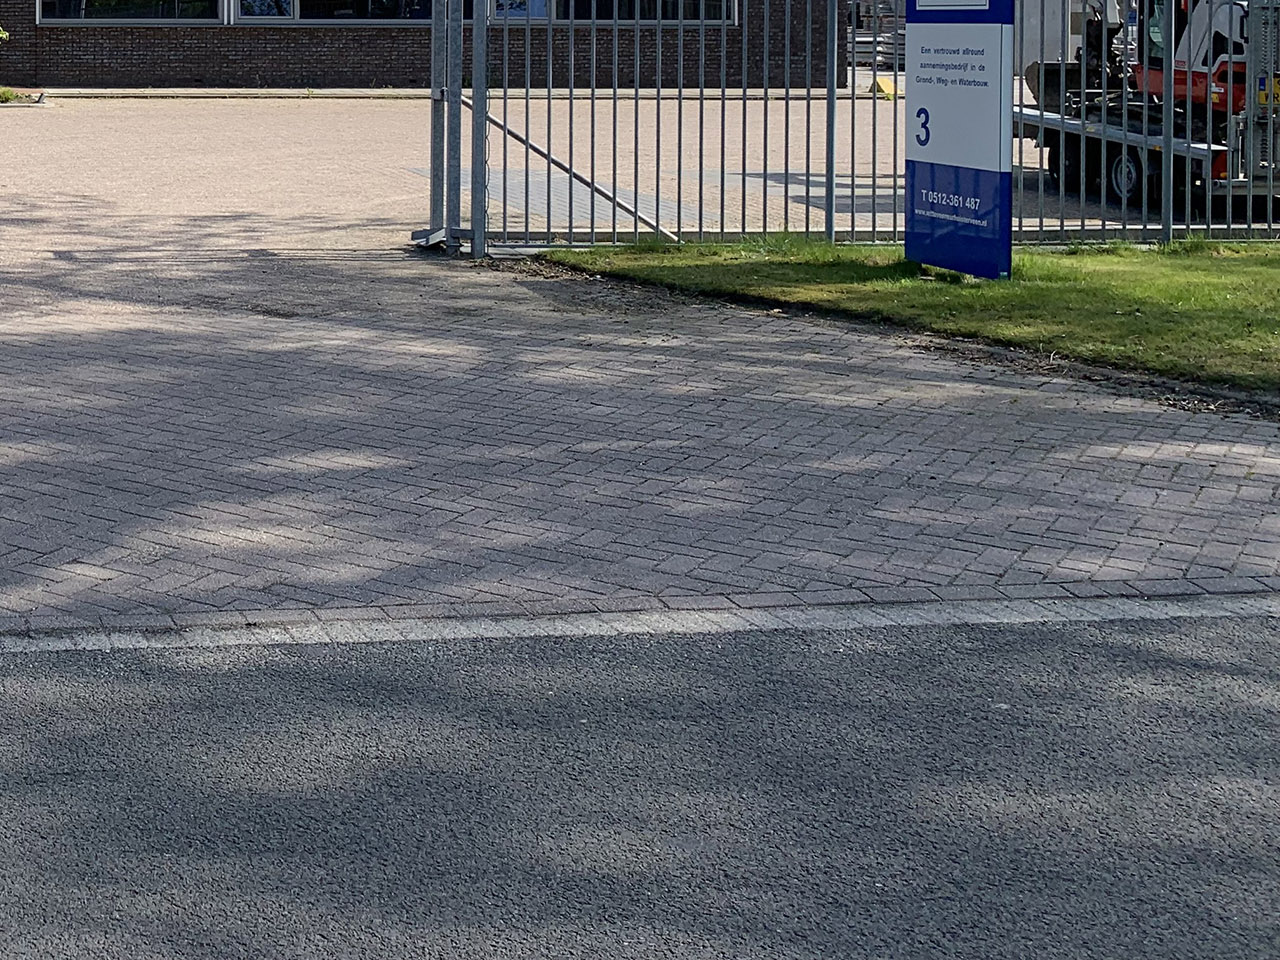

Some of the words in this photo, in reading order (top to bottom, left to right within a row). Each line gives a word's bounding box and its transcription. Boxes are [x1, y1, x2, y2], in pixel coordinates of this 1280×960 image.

[970, 63, 976, 71] in
[916, 107, 930, 146] 3
[921, 189, 927, 201] T
[928, 191, 963, 207] 0512-361
[965, 197, 980, 210] 487
